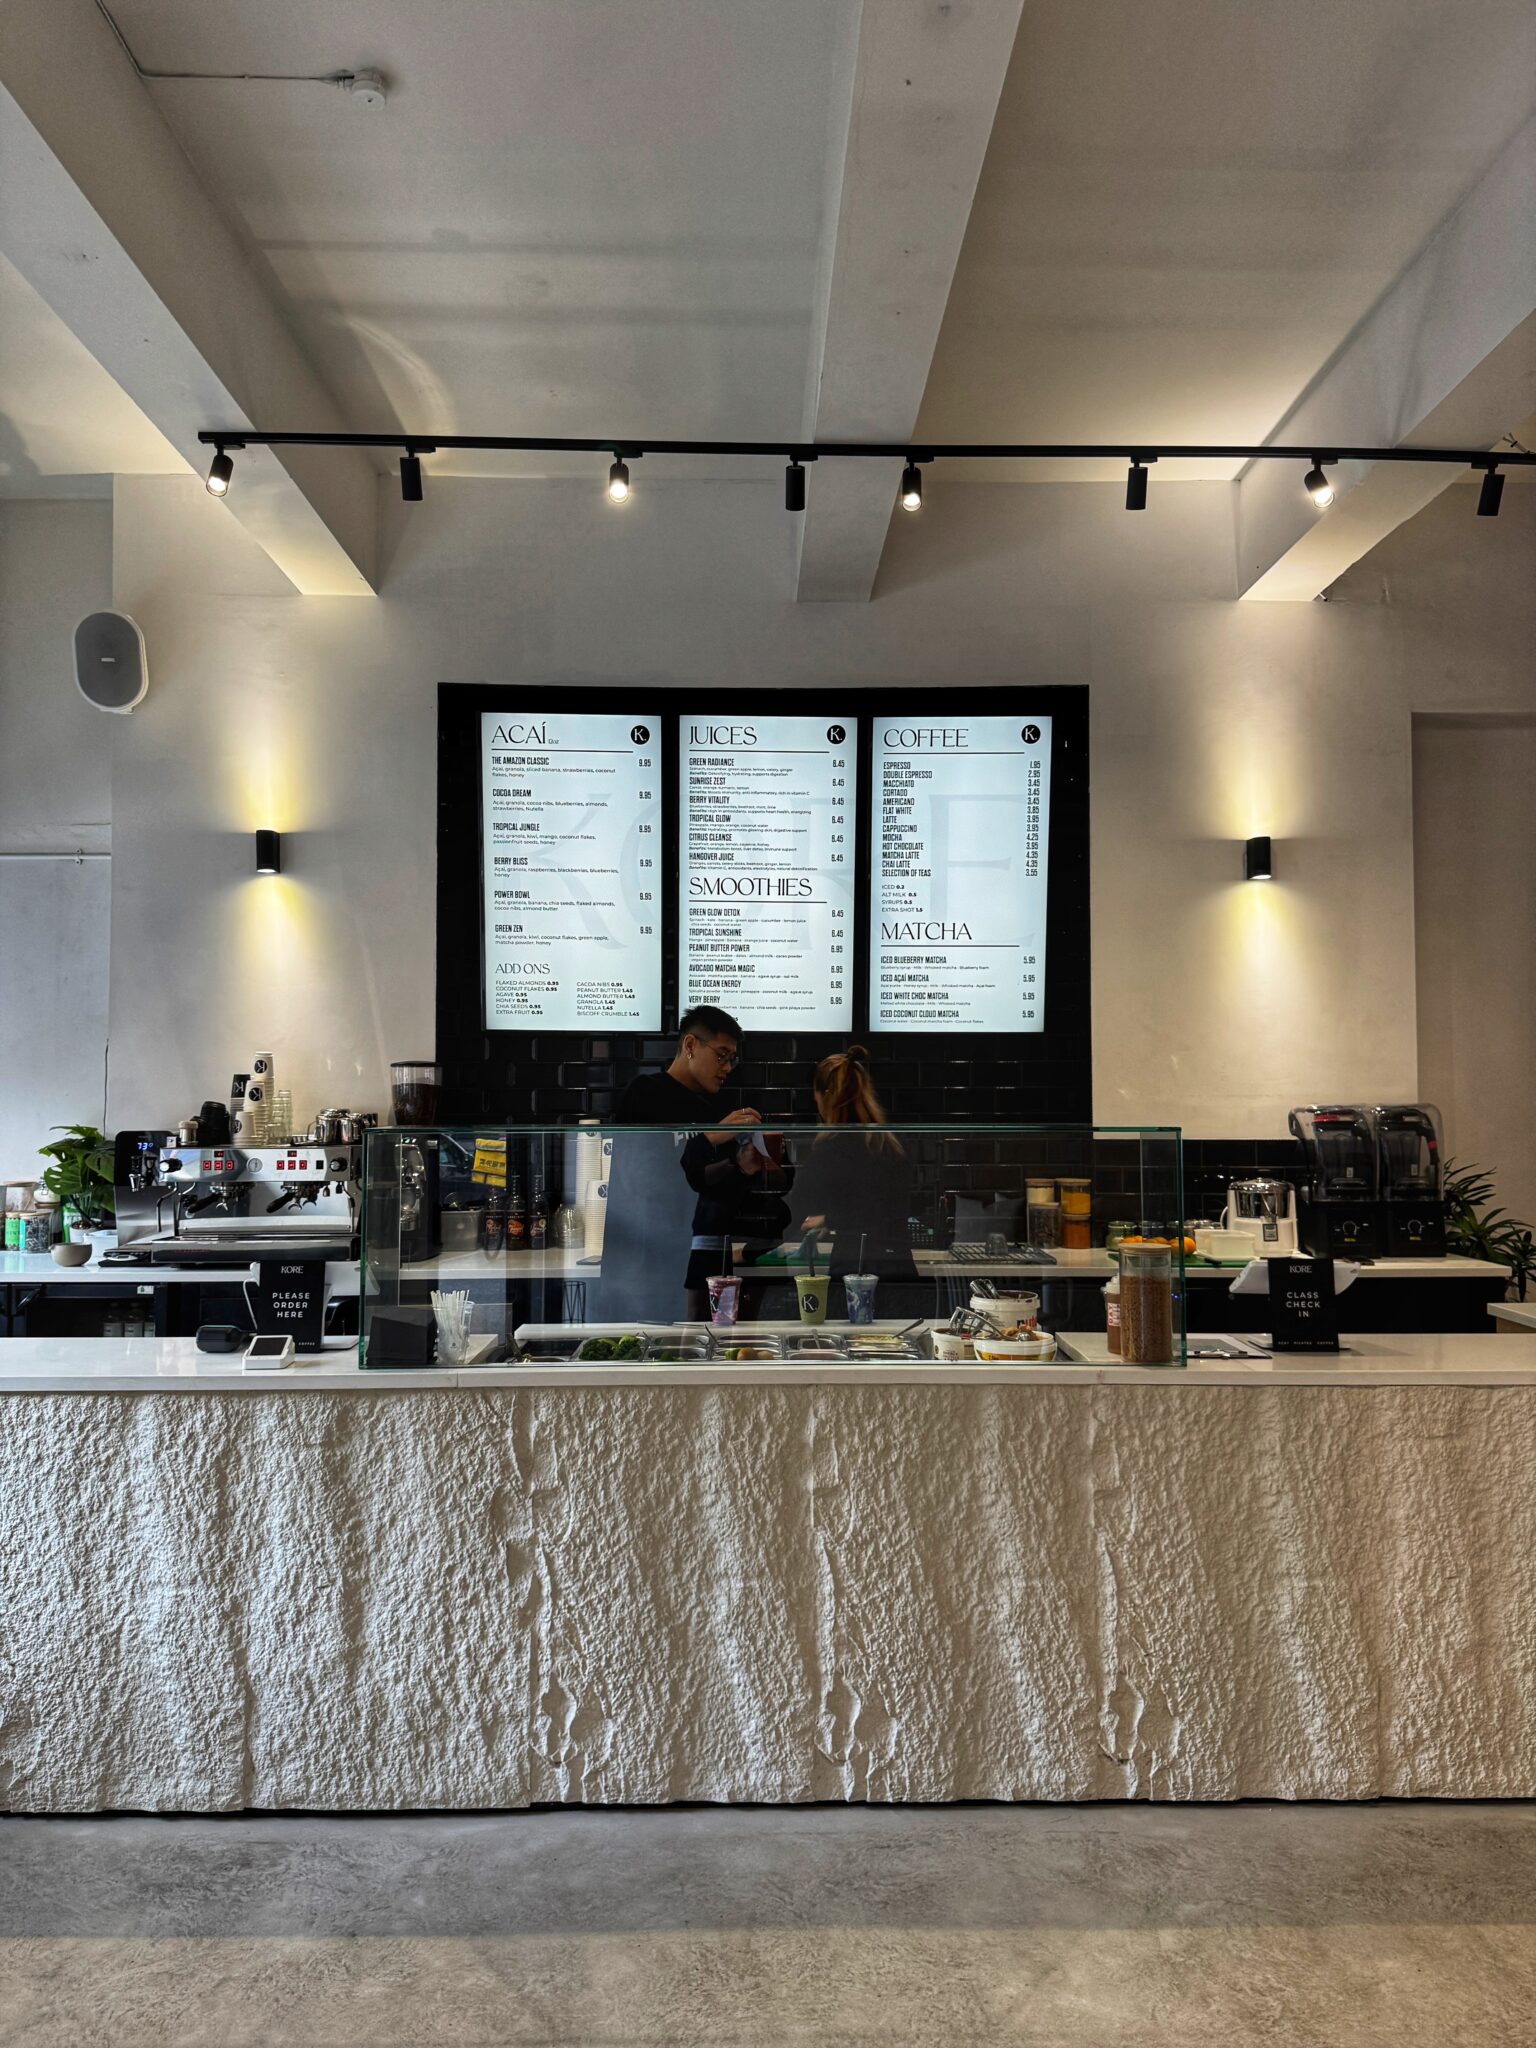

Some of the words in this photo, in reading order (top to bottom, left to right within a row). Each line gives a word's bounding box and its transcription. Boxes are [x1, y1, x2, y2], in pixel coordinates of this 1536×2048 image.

[689, 726, 757, 745] JUICES
[884, 729, 968, 747] COFFEE
[527, 757, 549, 765] CLASSIC
[639, 759, 651, 767] 9.95
[708, 758, 734, 766] RADIANCE
[1028, 788, 1040, 796] 3.45
[493, 823, 518, 831] TROPICAL
[519, 823, 540, 831] JUNGLE
[639, 825, 651, 833] 9.95
[1027, 824, 1039, 832] 3.95
[494, 857, 511, 865] BERRY
[640, 859, 652, 867] 9.95
[689, 877, 812, 896] SMOOTHIES
[640, 926, 652, 934] 9.95
[881, 922, 972, 940] MATCHA
[731, 944, 750, 952] POWER
[495, 963, 521, 974] ADD
[524, 964, 550, 974] ONS
[881, 974, 892, 982] ICED
[721, 980, 741, 988] ENERGY
[880, 1010, 892, 1018] ICED
[894, 1010, 918, 1018] COCONUT
[919, 1010, 936, 1018] CLOUD
[938, 1010, 959, 1018] MATCHA
[281, 1266, 304, 1274] KORE
